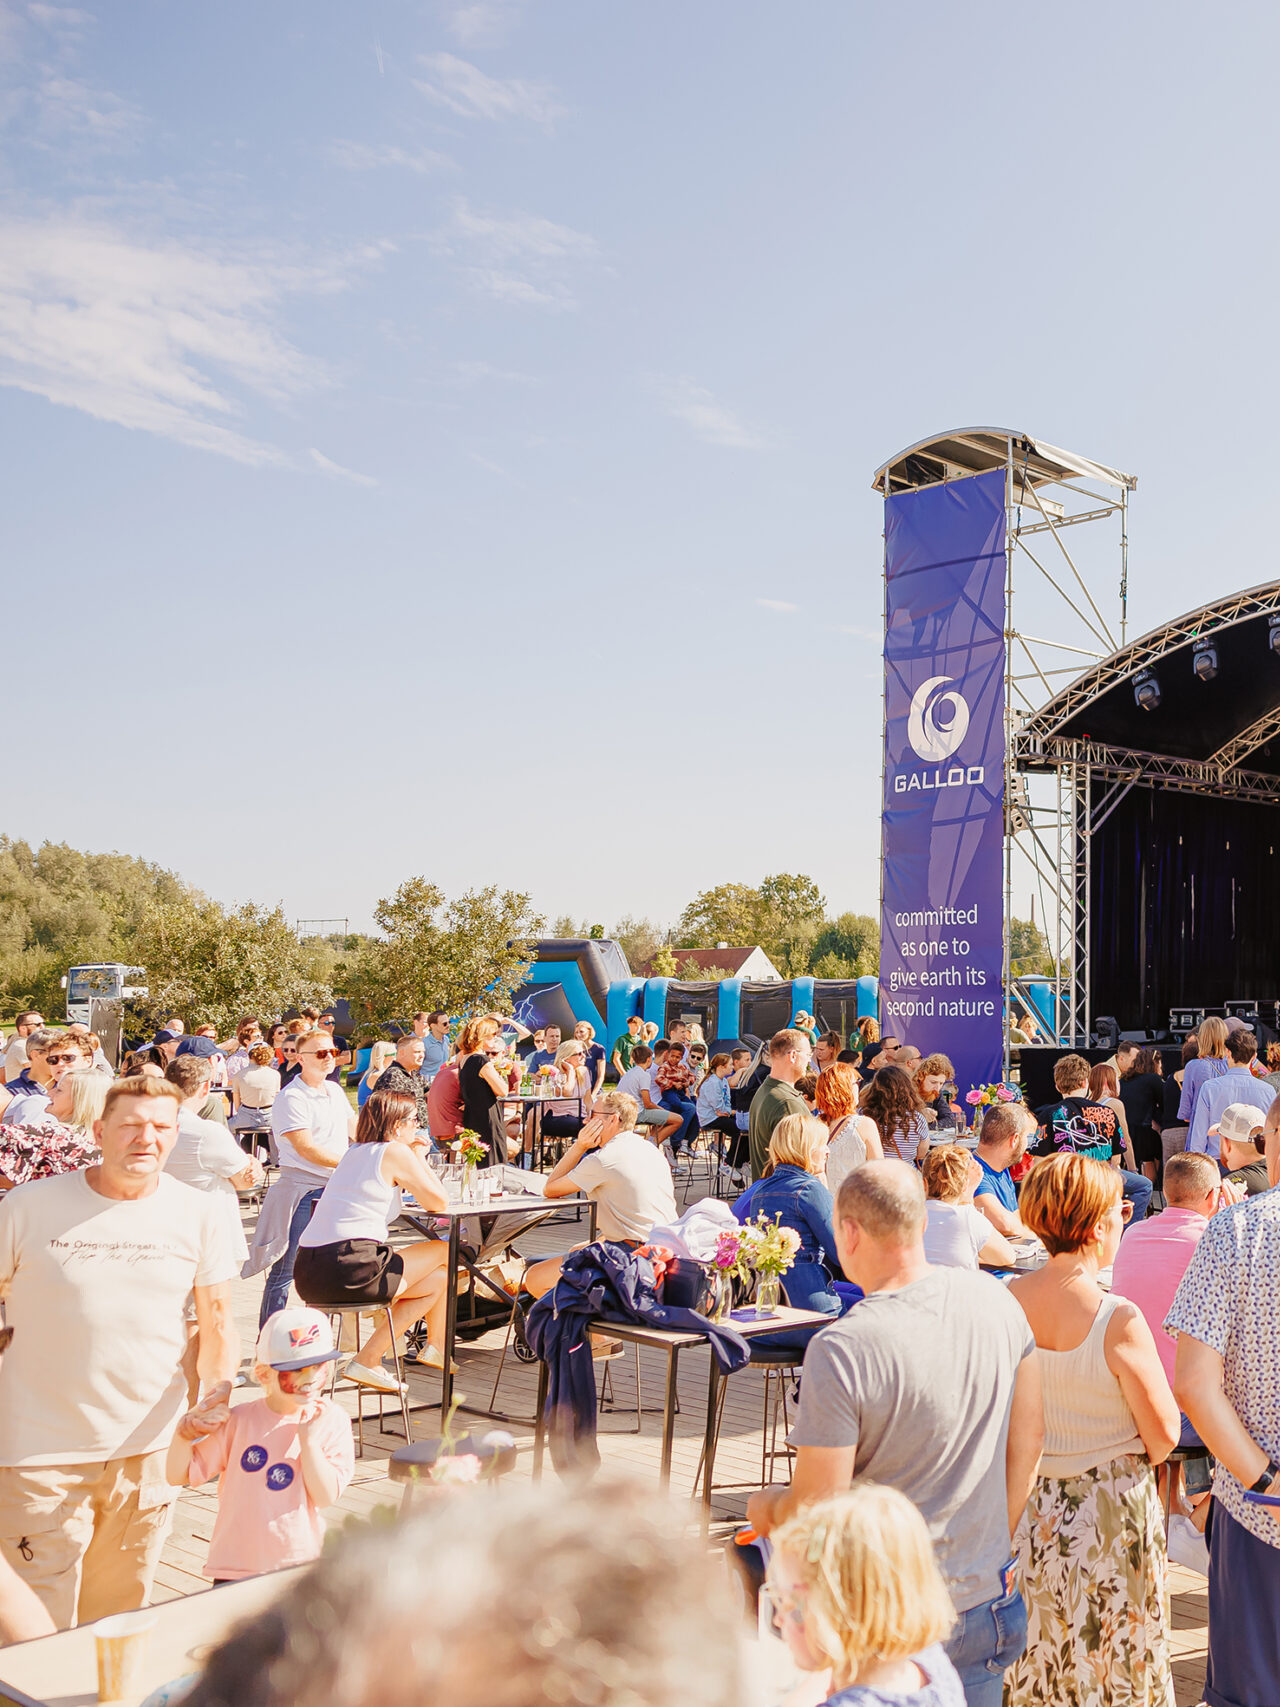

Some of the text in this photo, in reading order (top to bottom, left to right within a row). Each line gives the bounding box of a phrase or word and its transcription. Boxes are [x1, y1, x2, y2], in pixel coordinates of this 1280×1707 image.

[894, 766, 985, 793] GALLOO
[895, 903, 978, 927] committed
[901, 937, 970, 957] as one to
[889, 965, 987, 992] give earth its
[887, 996, 995, 1017] second nature
[50, 1239, 69, 1248] The
[74, 1239, 119, 1250] Original
